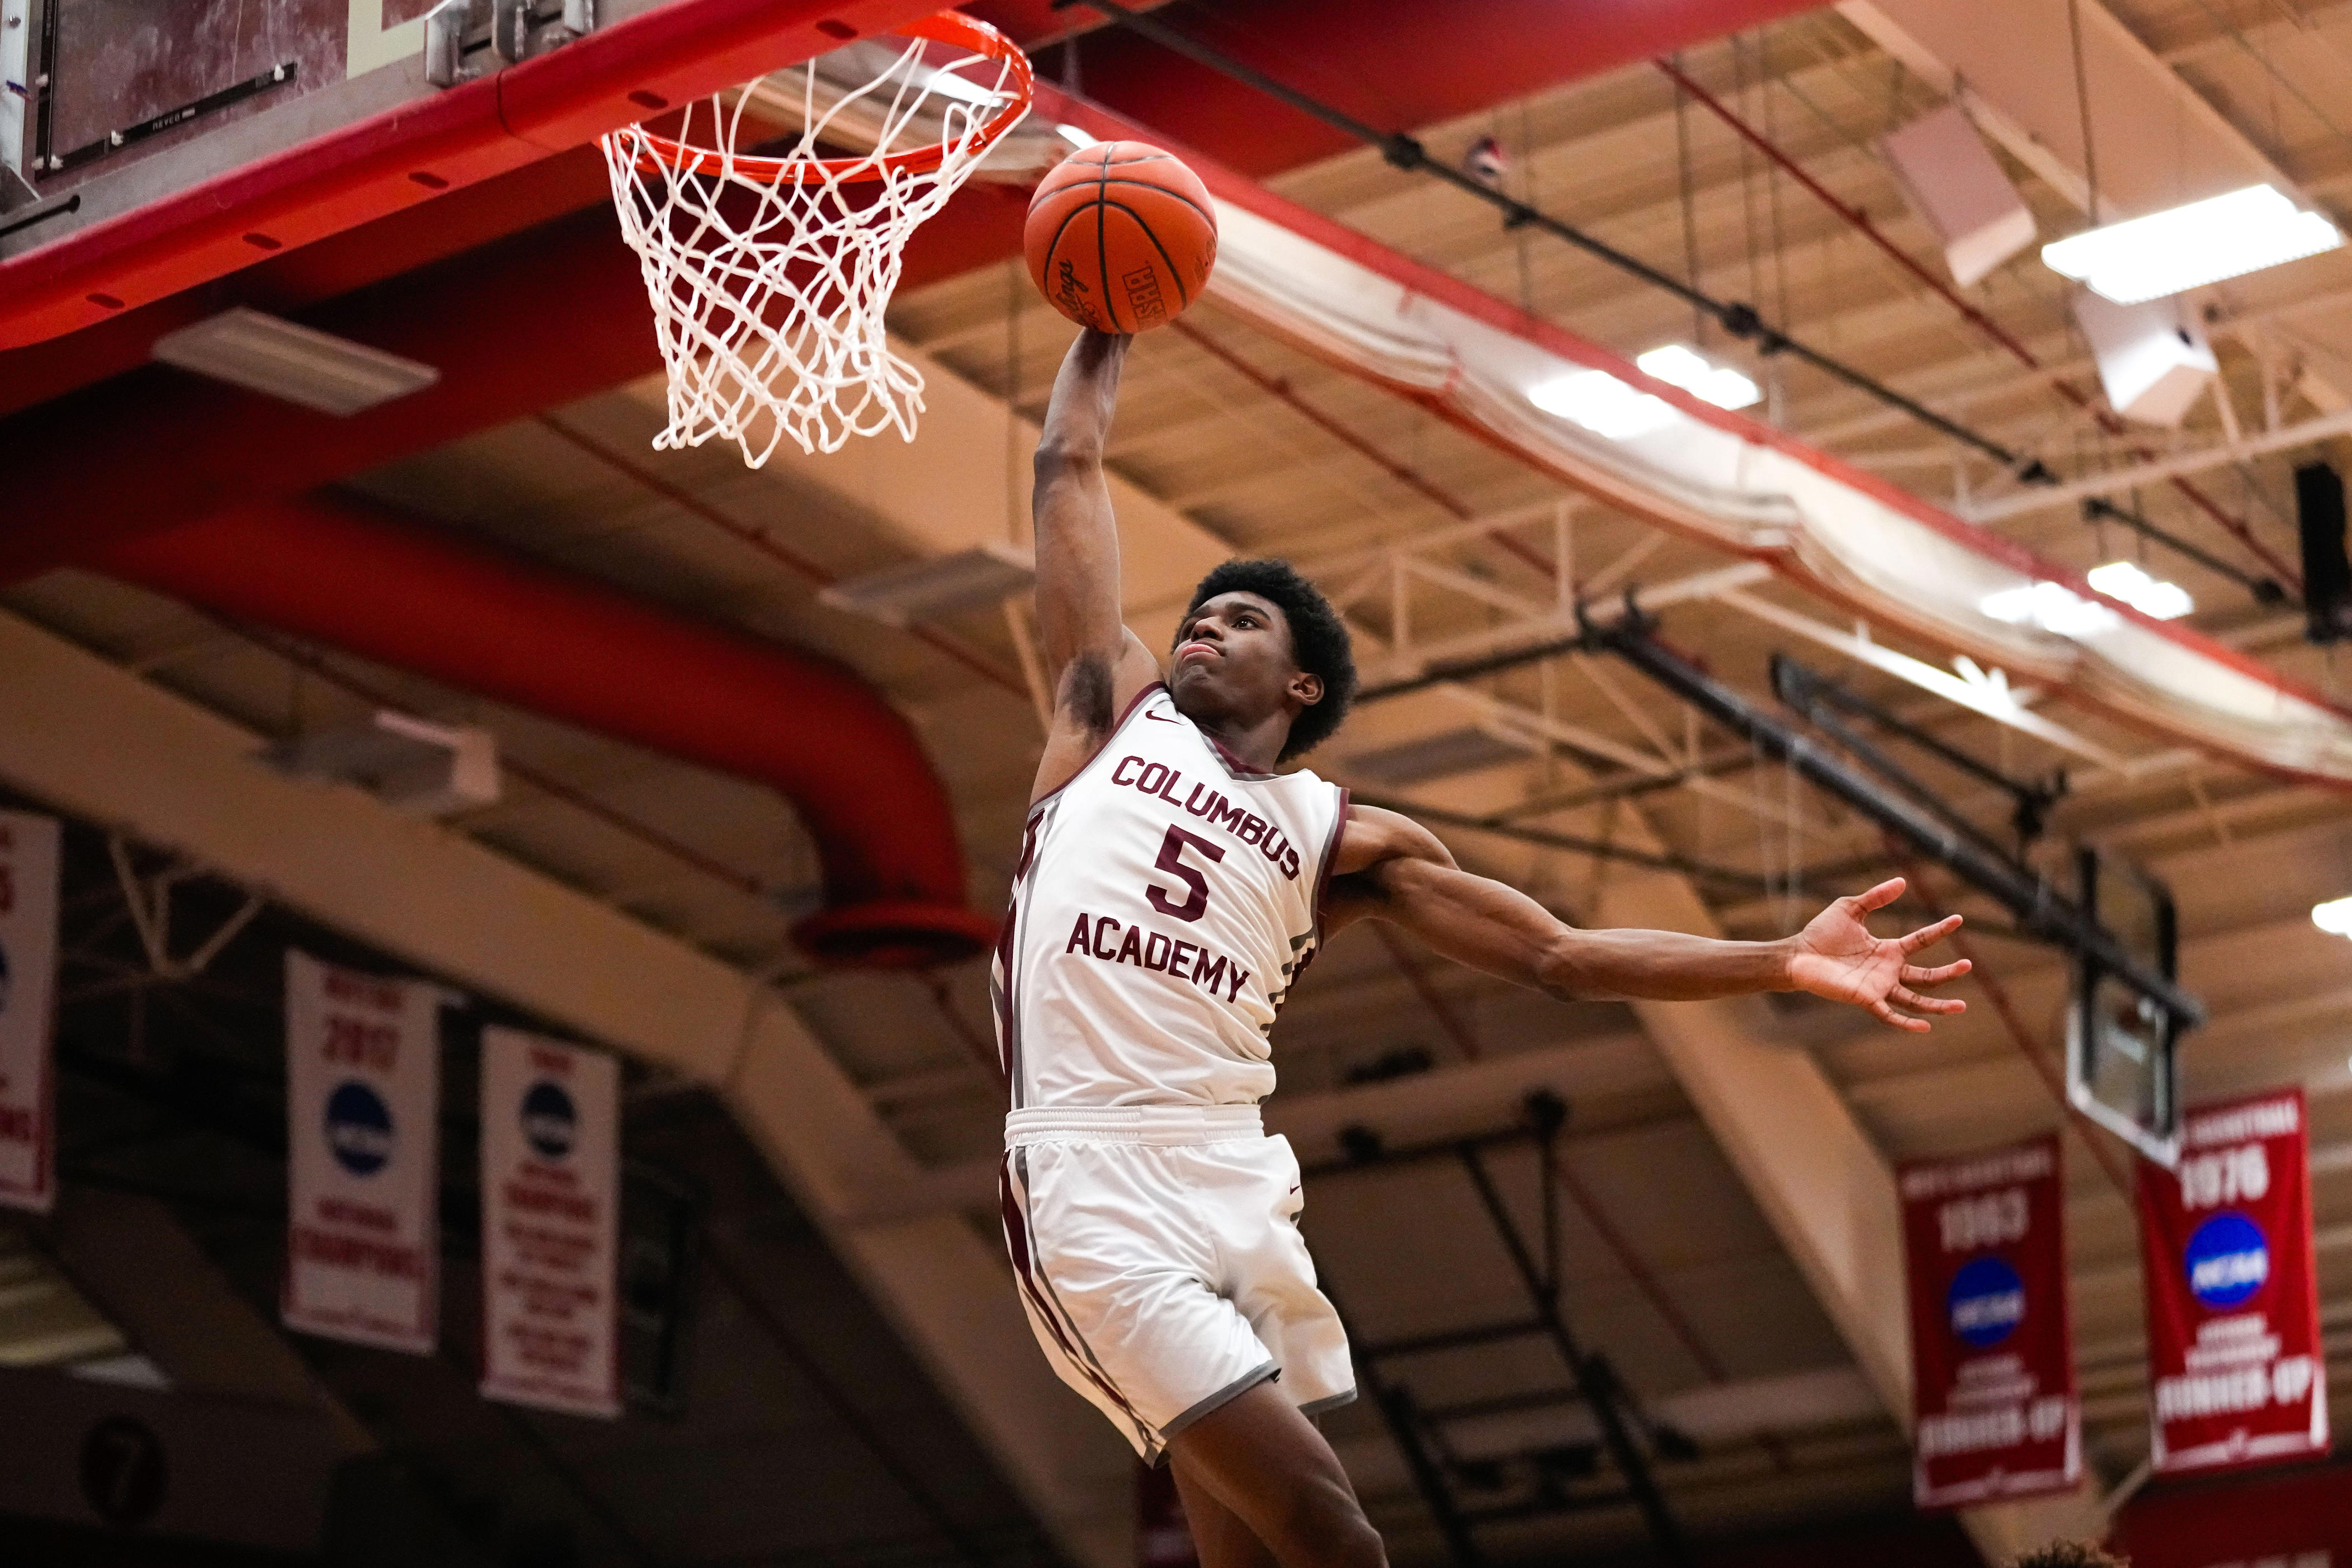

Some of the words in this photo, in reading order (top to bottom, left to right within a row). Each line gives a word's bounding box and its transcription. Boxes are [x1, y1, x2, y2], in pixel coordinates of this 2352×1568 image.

[1111, 755, 1300, 881] COLUMBUS
[1145, 823, 1226, 923] 5
[1066, 913, 1250, 1004] ACADEMY
